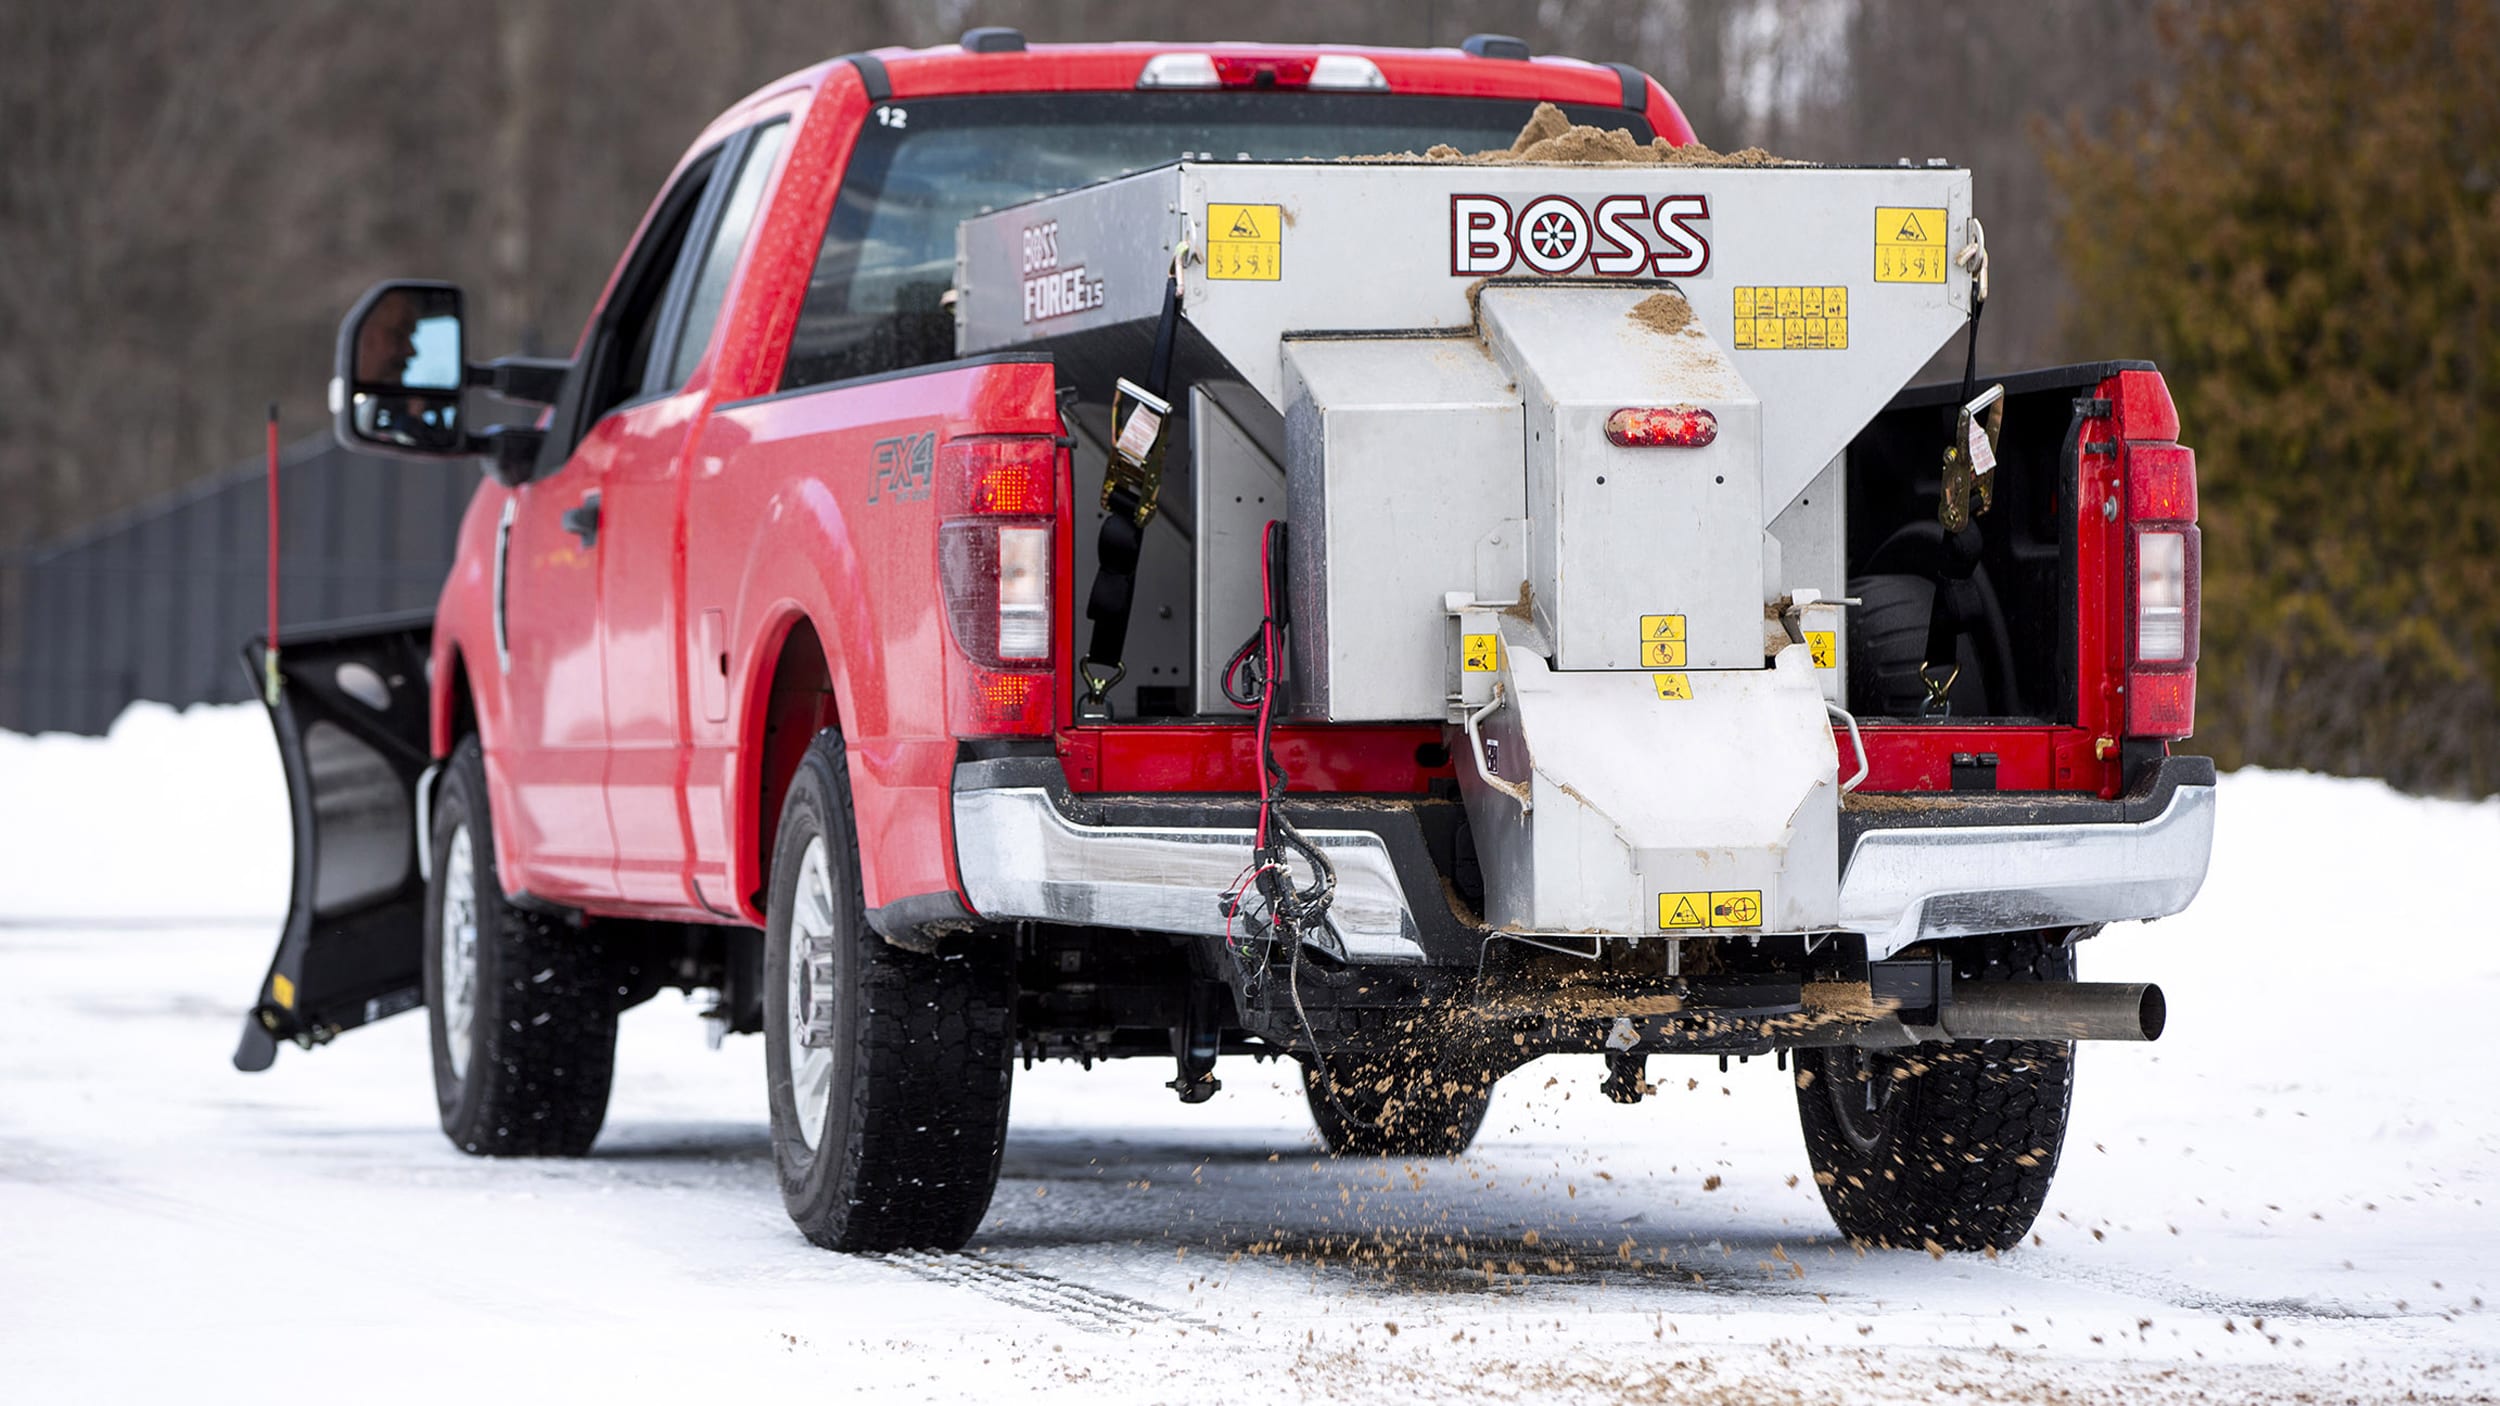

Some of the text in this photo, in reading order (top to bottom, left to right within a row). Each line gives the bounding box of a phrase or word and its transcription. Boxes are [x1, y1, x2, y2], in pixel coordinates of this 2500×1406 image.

[876, 105, 907, 129] 12
[1023, 220, 1058, 274] BOSS
[1450, 194, 1710, 277] BOSS
[867, 432, 935, 505] FX4
